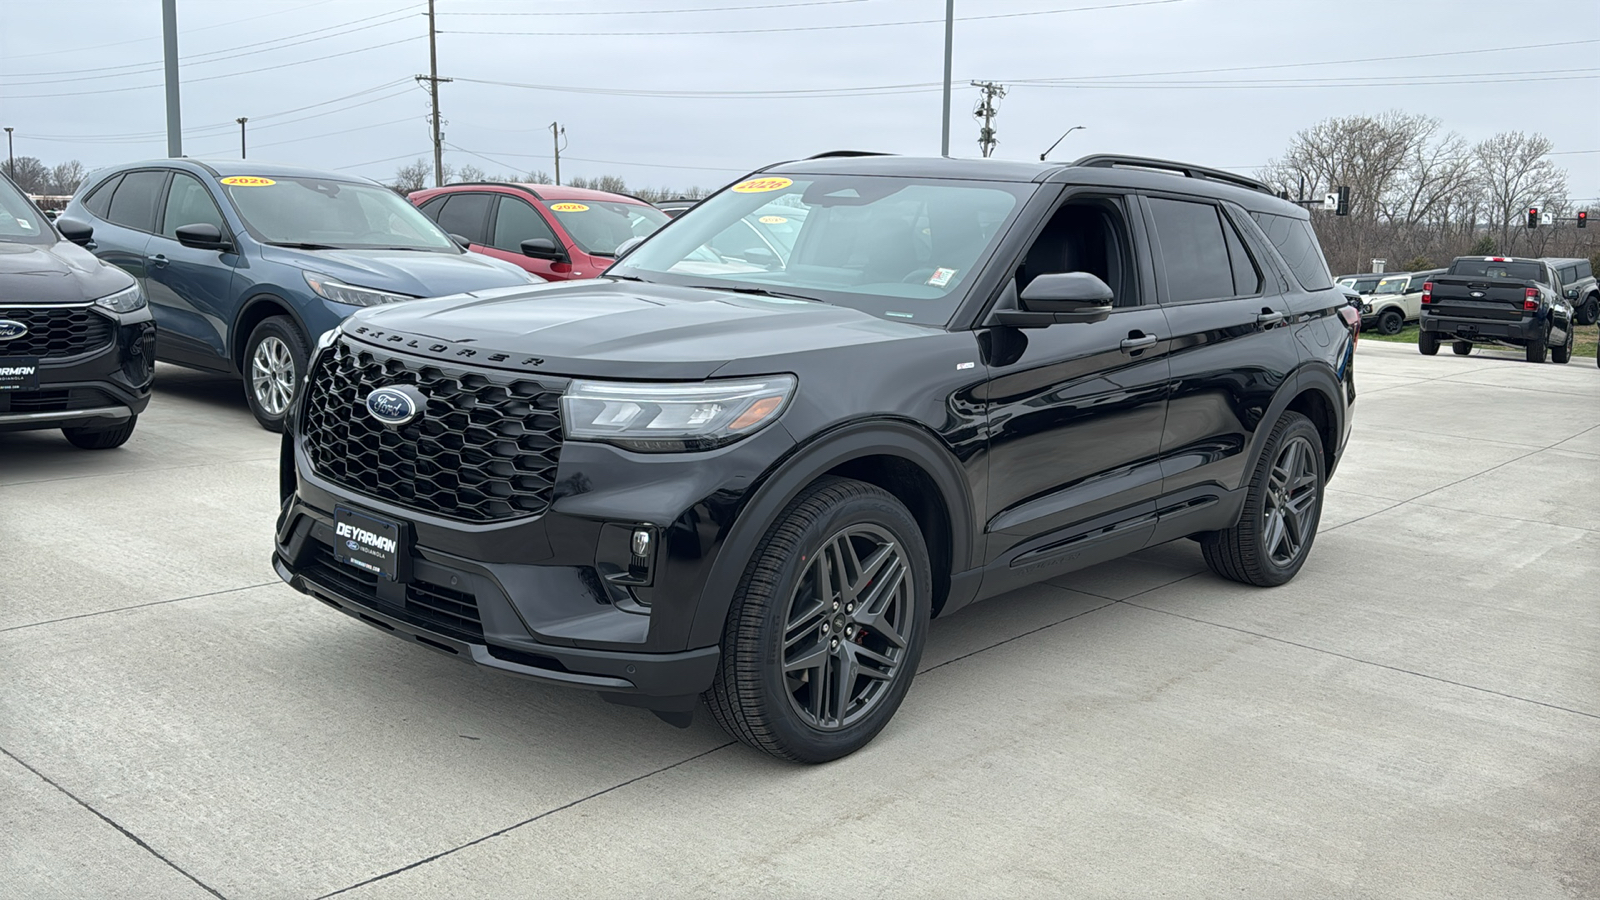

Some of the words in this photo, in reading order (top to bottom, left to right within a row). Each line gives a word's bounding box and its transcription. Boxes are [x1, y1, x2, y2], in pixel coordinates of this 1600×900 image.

[355, 326, 545, 366] EXPLORER
[0, 366, 36, 376] RMAN
[373, 394, 402, 416] Ford
[336, 522, 396, 553] DEYARMAN
[360, 546, 386, 559] INDIANOLA
